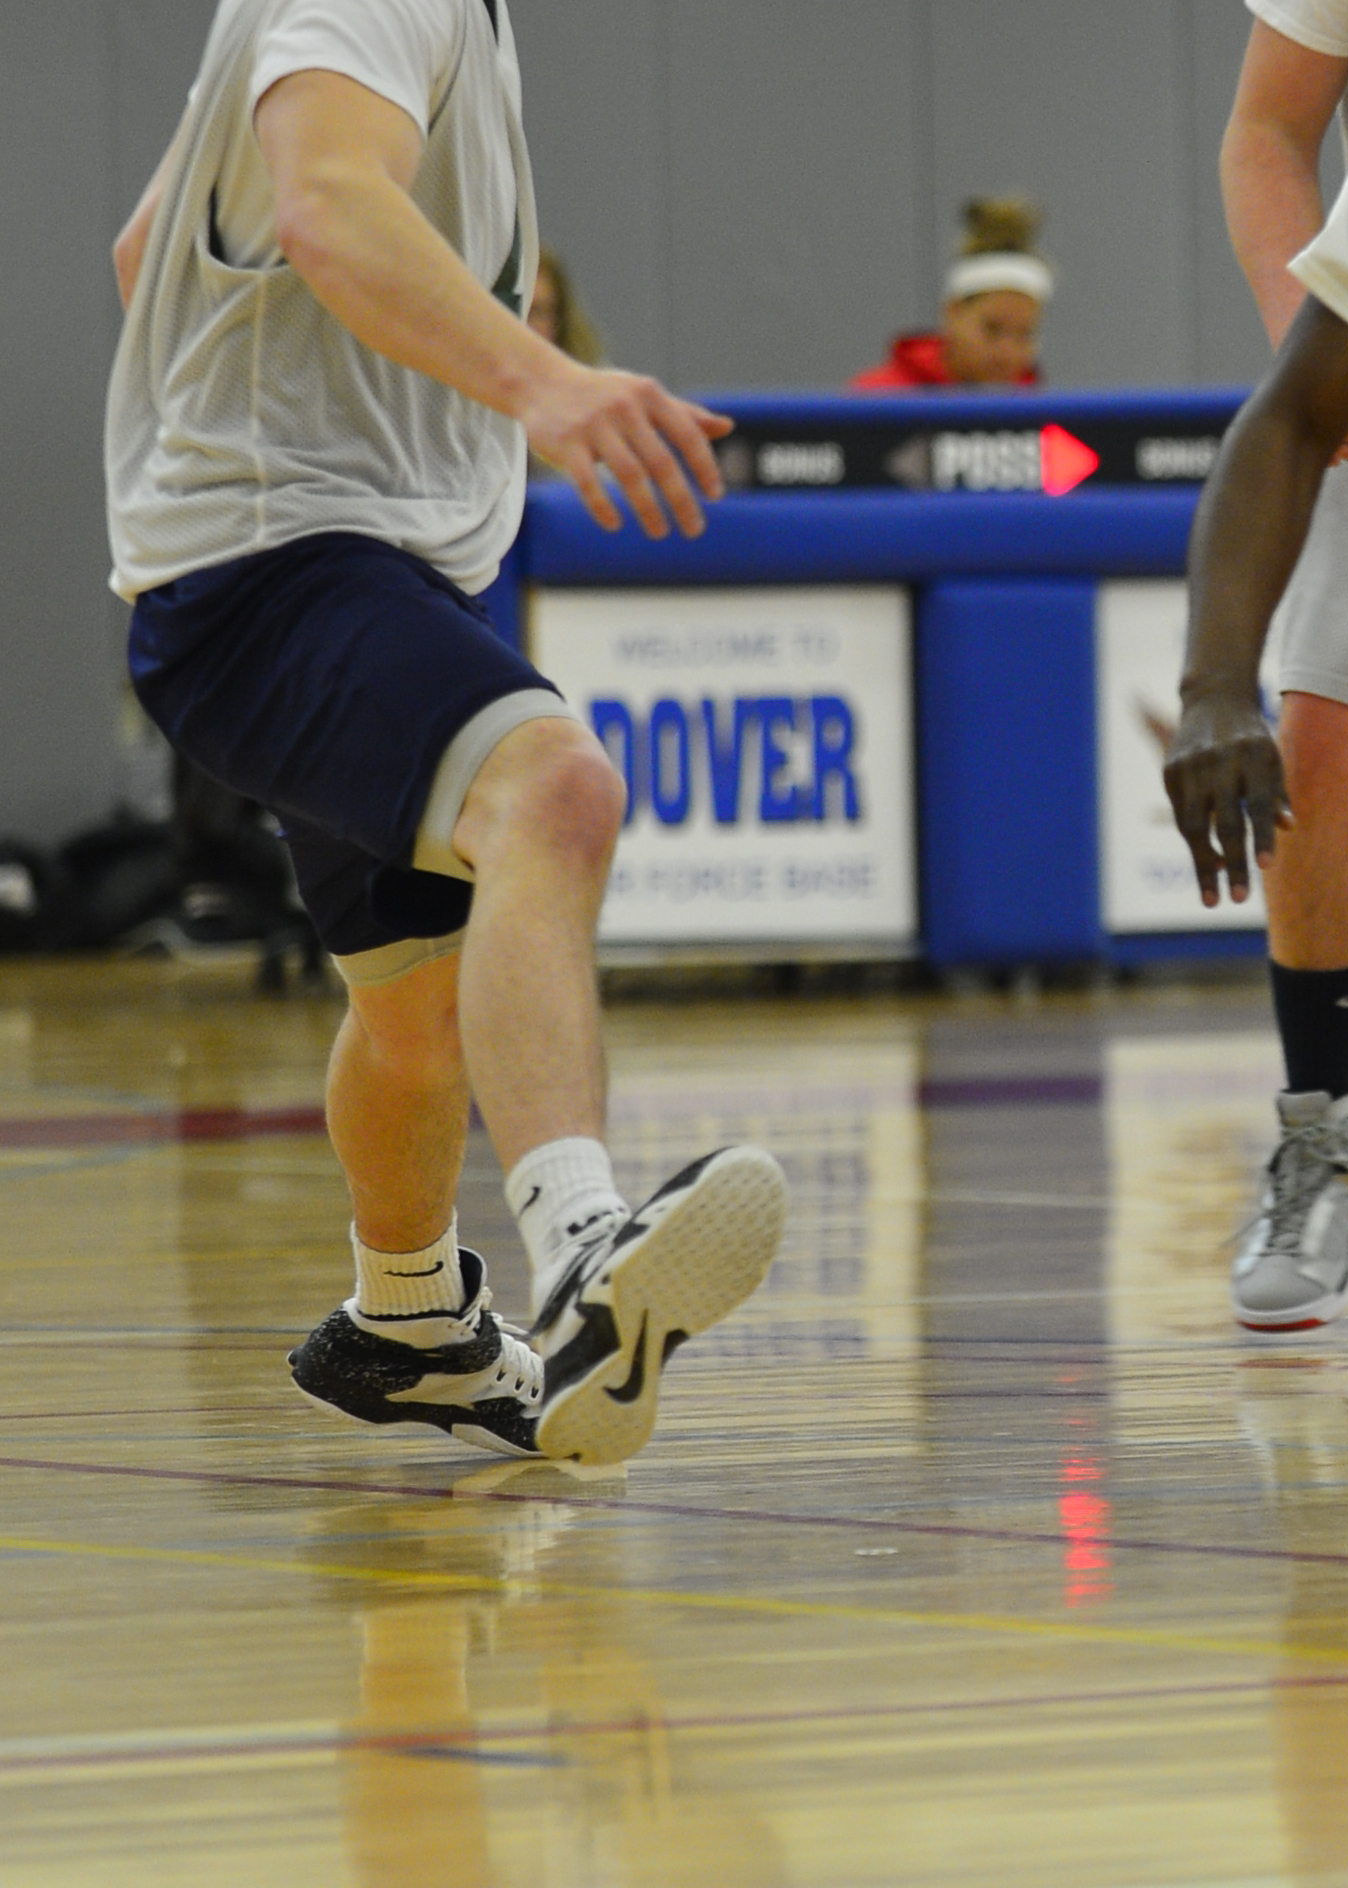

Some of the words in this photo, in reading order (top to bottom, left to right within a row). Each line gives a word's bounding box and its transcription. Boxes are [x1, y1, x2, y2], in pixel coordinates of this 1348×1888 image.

[932, 430, 1041, 492] POSS
[614, 629, 777, 665] WELCOME
[793, 627, 840, 664] TO
[589, 694, 861, 826] DOVER
